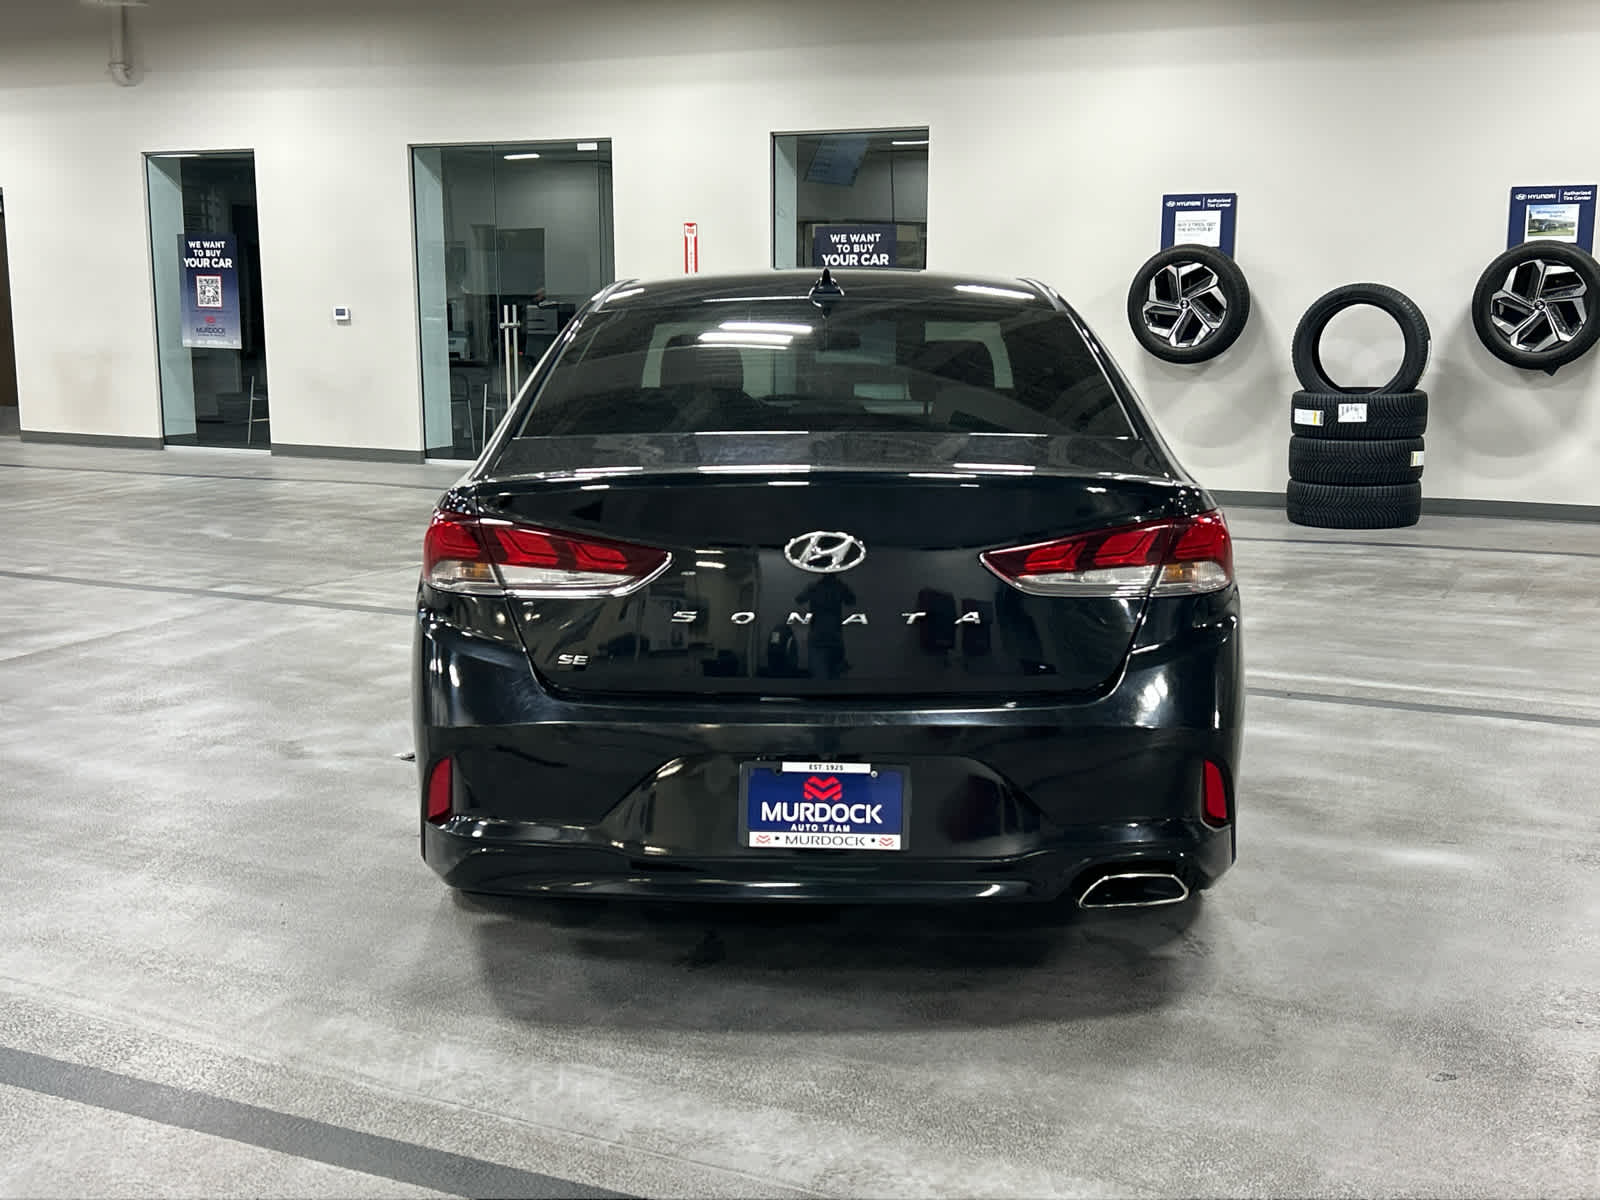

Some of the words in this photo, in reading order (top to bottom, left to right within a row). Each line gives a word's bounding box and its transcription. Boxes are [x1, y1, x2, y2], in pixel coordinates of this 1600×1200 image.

[829, 233, 847, 243] WE
[850, 233, 881, 243] WANT
[193, 249, 204, 257] TO
[836, 244, 850, 253] TO
[853, 244, 874, 252] BUY
[184, 258, 210, 268] YOUR
[211, 258, 233, 269] CAR
[822, 254, 858, 266] YOUR
[860, 254, 889, 265] CAR
[671, 610, 981, 624] SONATA
[557, 654, 589, 665] SE
[761, 802, 882, 824] MURDOCK
[790, 823, 819, 832] AUTO
[823, 824, 851, 833] TEAM
[785, 835, 865, 847] MURDOCK
